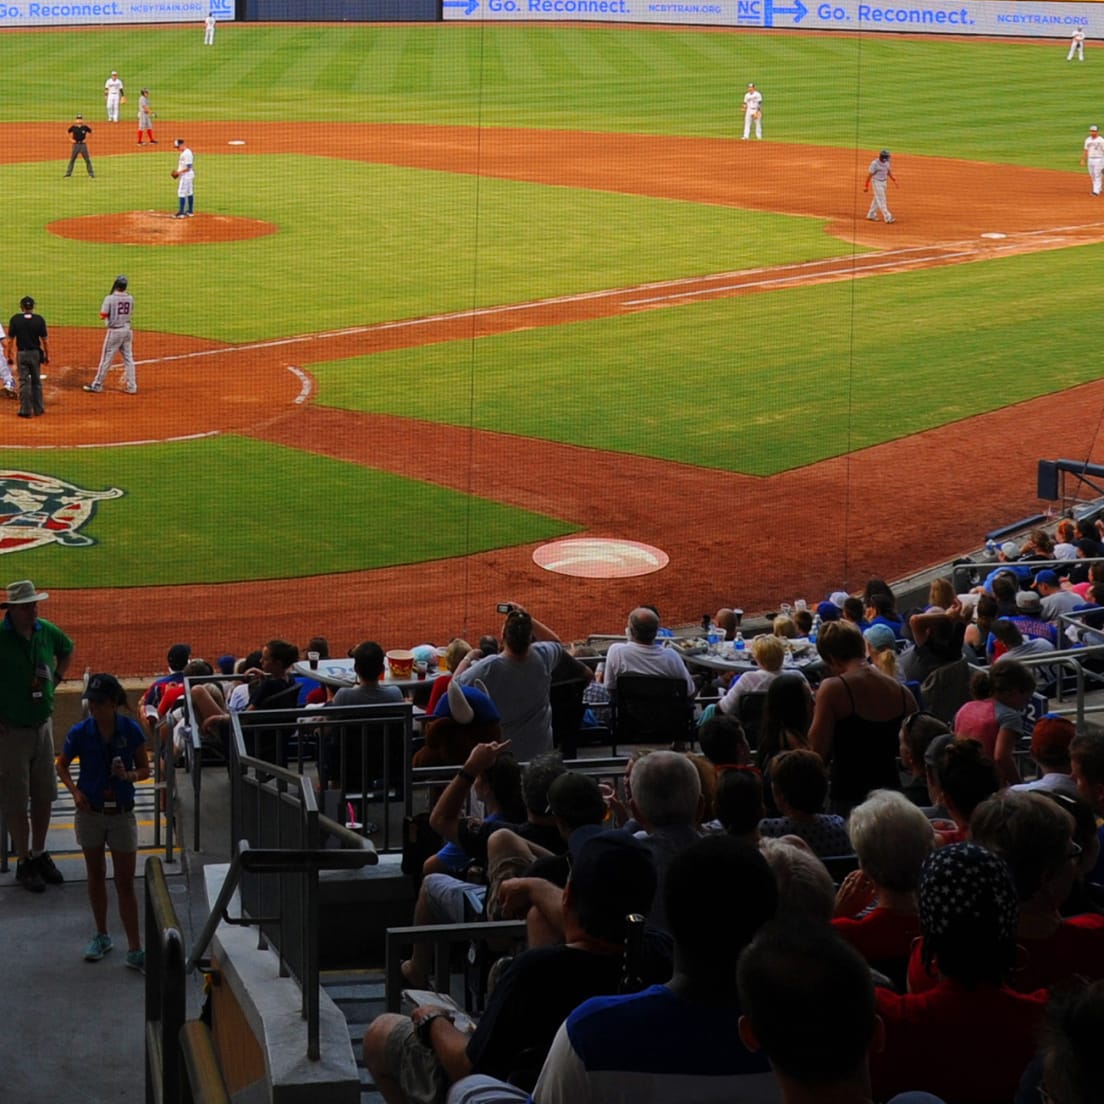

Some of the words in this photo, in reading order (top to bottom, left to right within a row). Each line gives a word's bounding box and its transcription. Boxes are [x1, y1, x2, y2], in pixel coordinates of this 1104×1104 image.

[30, 1, 123, 17] Reconnect.
[648, 4, 721, 14] NCBYTRAIN.ORG
[738, 1, 760, 14] NC
[818, 4, 850, 20] Go.
[858, 4, 975, 25] Reconnect.
[997, 14, 1088, 26] NCBYTRAIN.ORG
